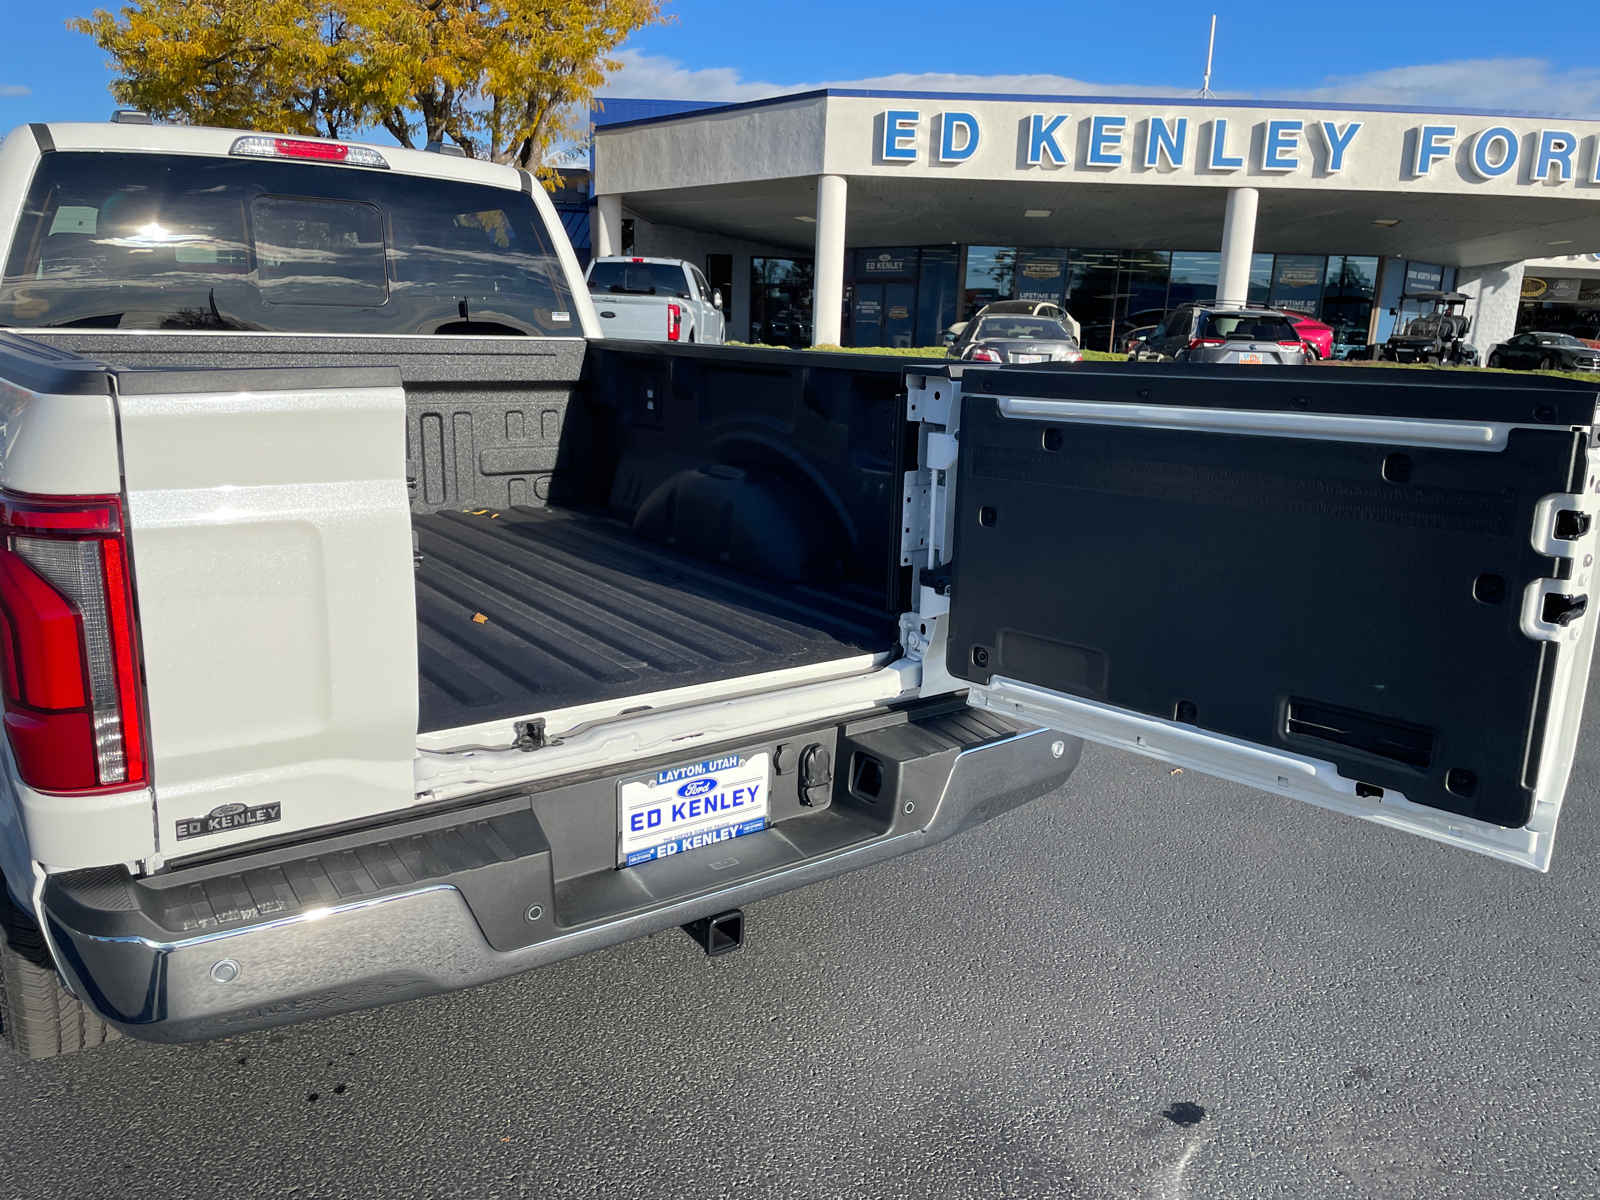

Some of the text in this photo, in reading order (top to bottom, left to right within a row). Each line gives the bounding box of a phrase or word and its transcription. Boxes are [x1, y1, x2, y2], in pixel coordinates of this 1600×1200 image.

[882, 108, 1600, 183] ED KENLEY FOR
[658, 755, 739, 784] LAYTON, UTAH
[177, 806, 279, 836] ED KENLEY
[630, 784, 760, 832] ED KENLEY
